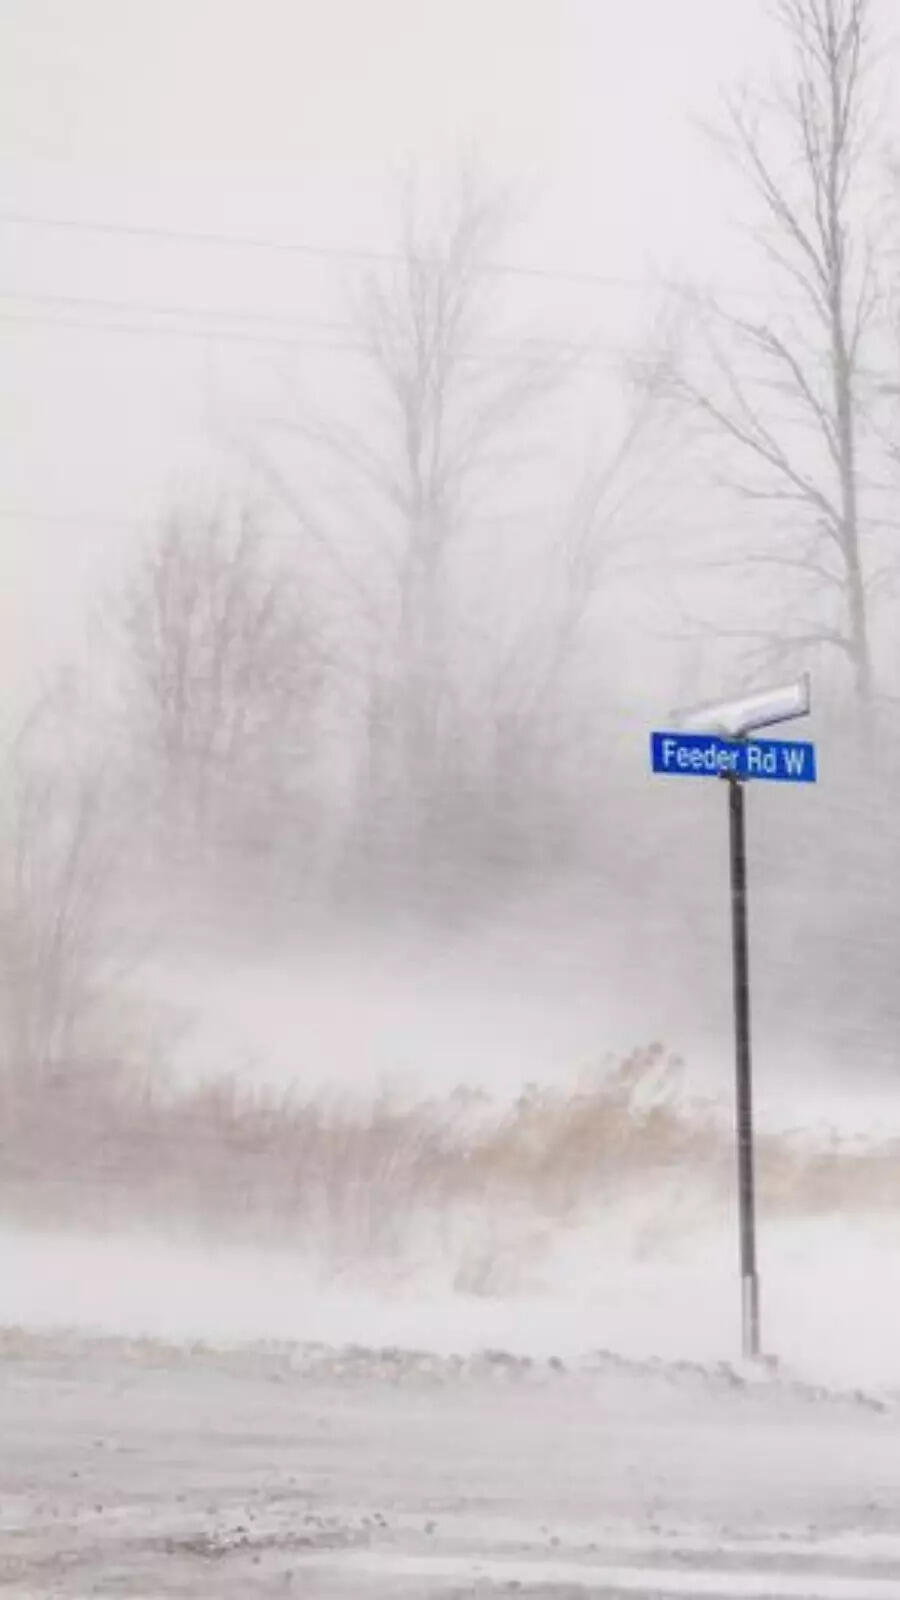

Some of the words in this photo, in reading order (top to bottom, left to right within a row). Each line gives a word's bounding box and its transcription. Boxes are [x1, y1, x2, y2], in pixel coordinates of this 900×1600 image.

[662, 739, 739, 770] Feeder
[747, 745, 776, 773] Rd
[783, 747, 805, 776] W
